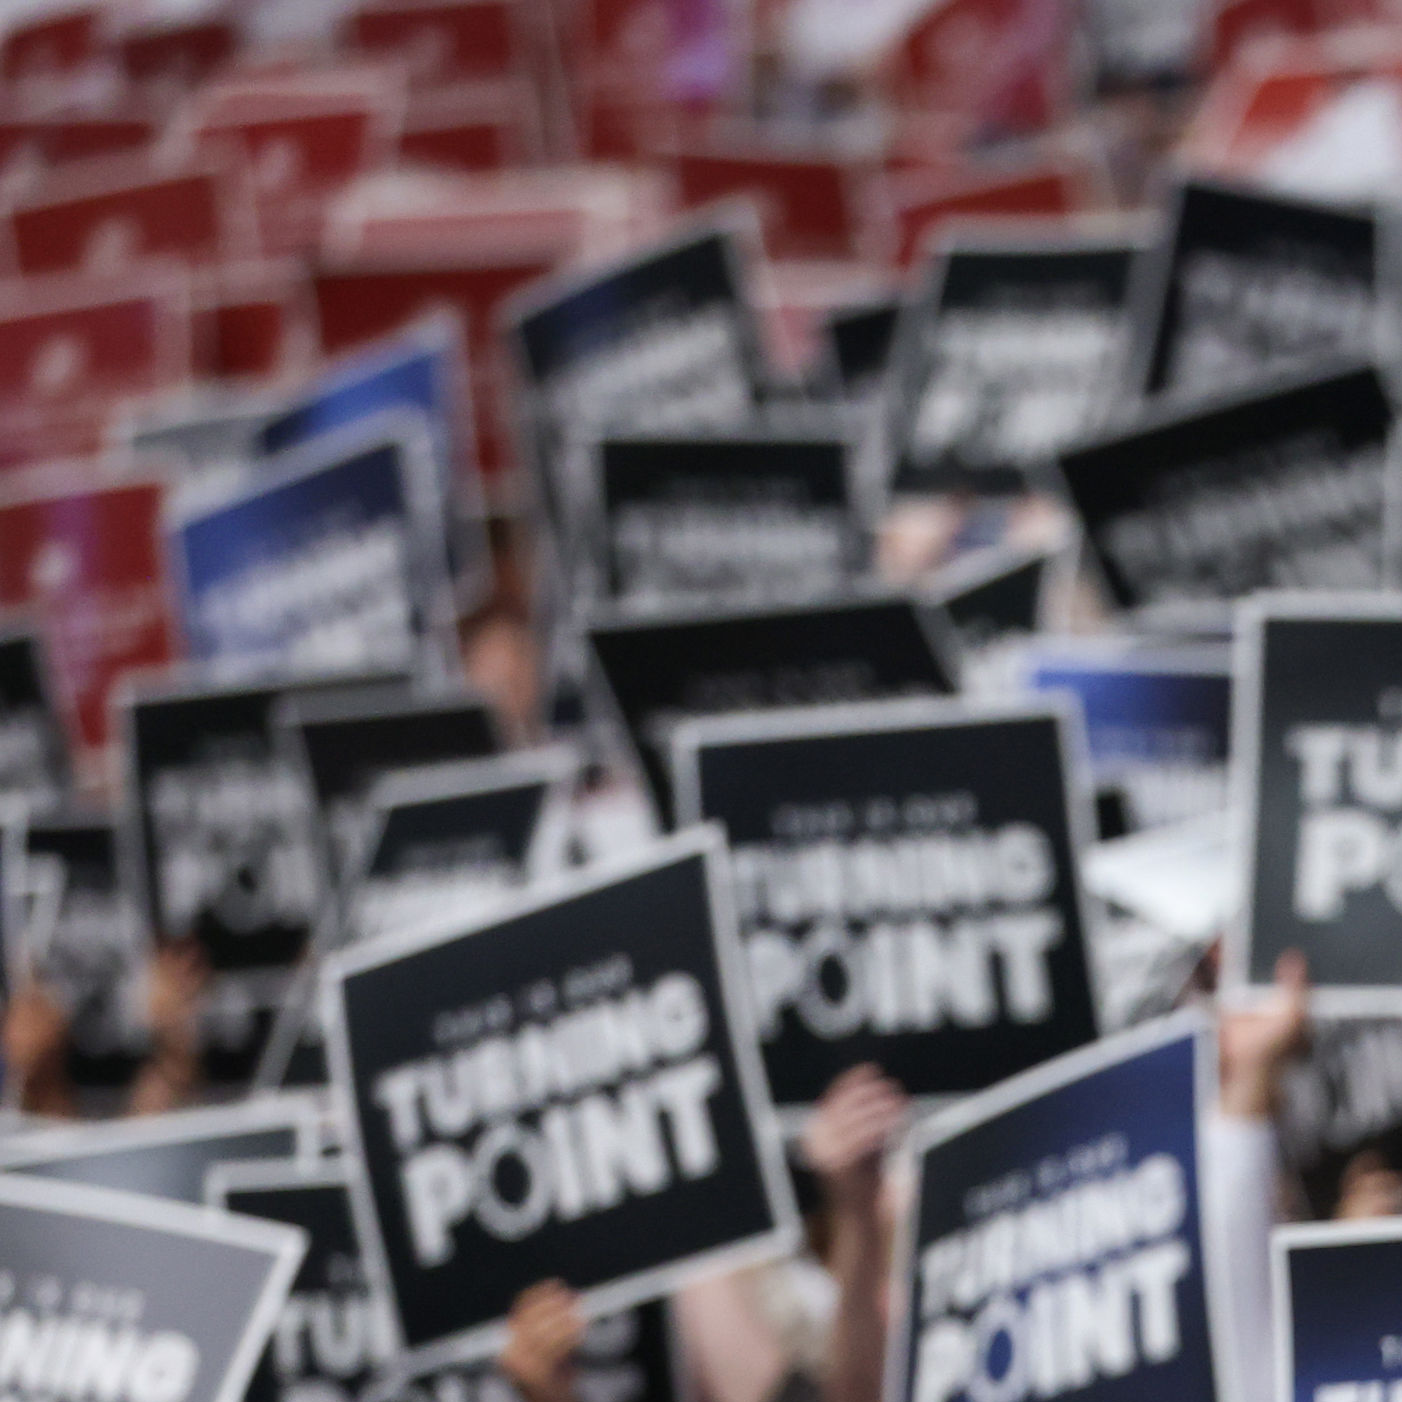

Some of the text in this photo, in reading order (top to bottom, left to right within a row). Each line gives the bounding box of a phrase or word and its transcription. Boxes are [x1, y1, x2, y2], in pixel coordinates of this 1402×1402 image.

[376, 973, 707, 1150] TURNING
[401, 1057, 725, 1268] POINT
[922, 1153, 1187, 1319] TURNING
